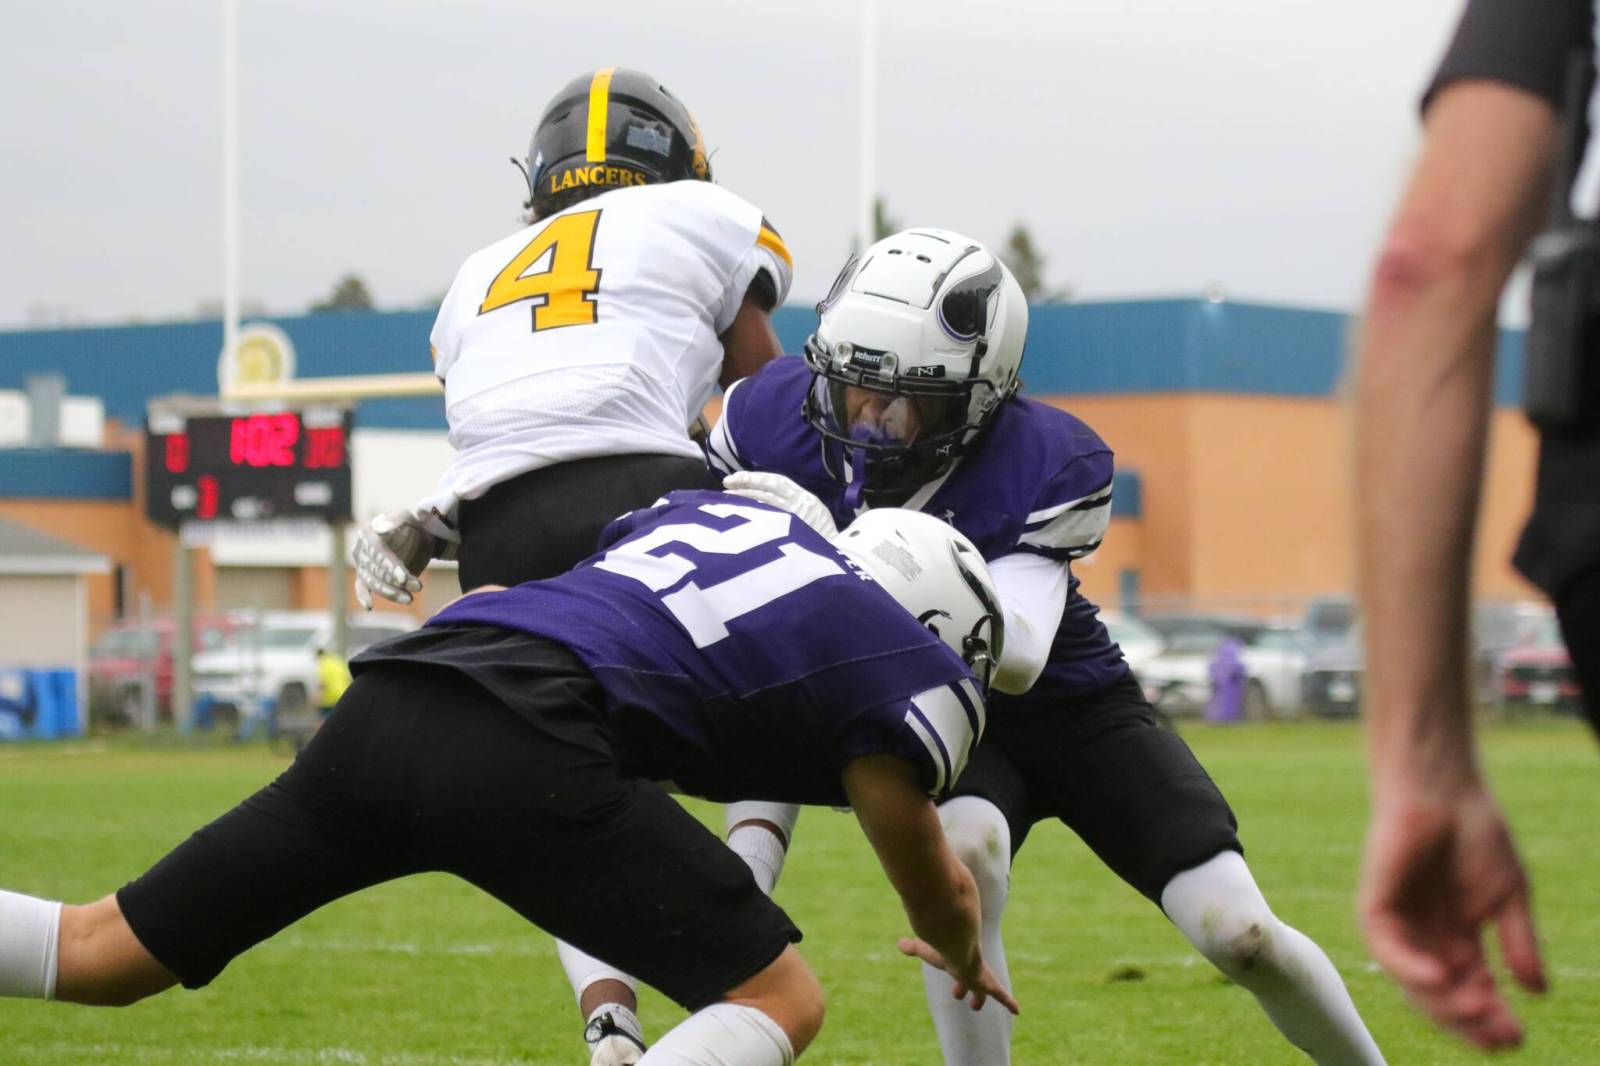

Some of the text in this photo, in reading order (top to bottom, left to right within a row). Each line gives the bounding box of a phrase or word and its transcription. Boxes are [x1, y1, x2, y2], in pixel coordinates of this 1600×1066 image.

[551, 165, 646, 193] LANCERS
[476, 209, 603, 333] 4
[592, 503, 847, 649] 21
